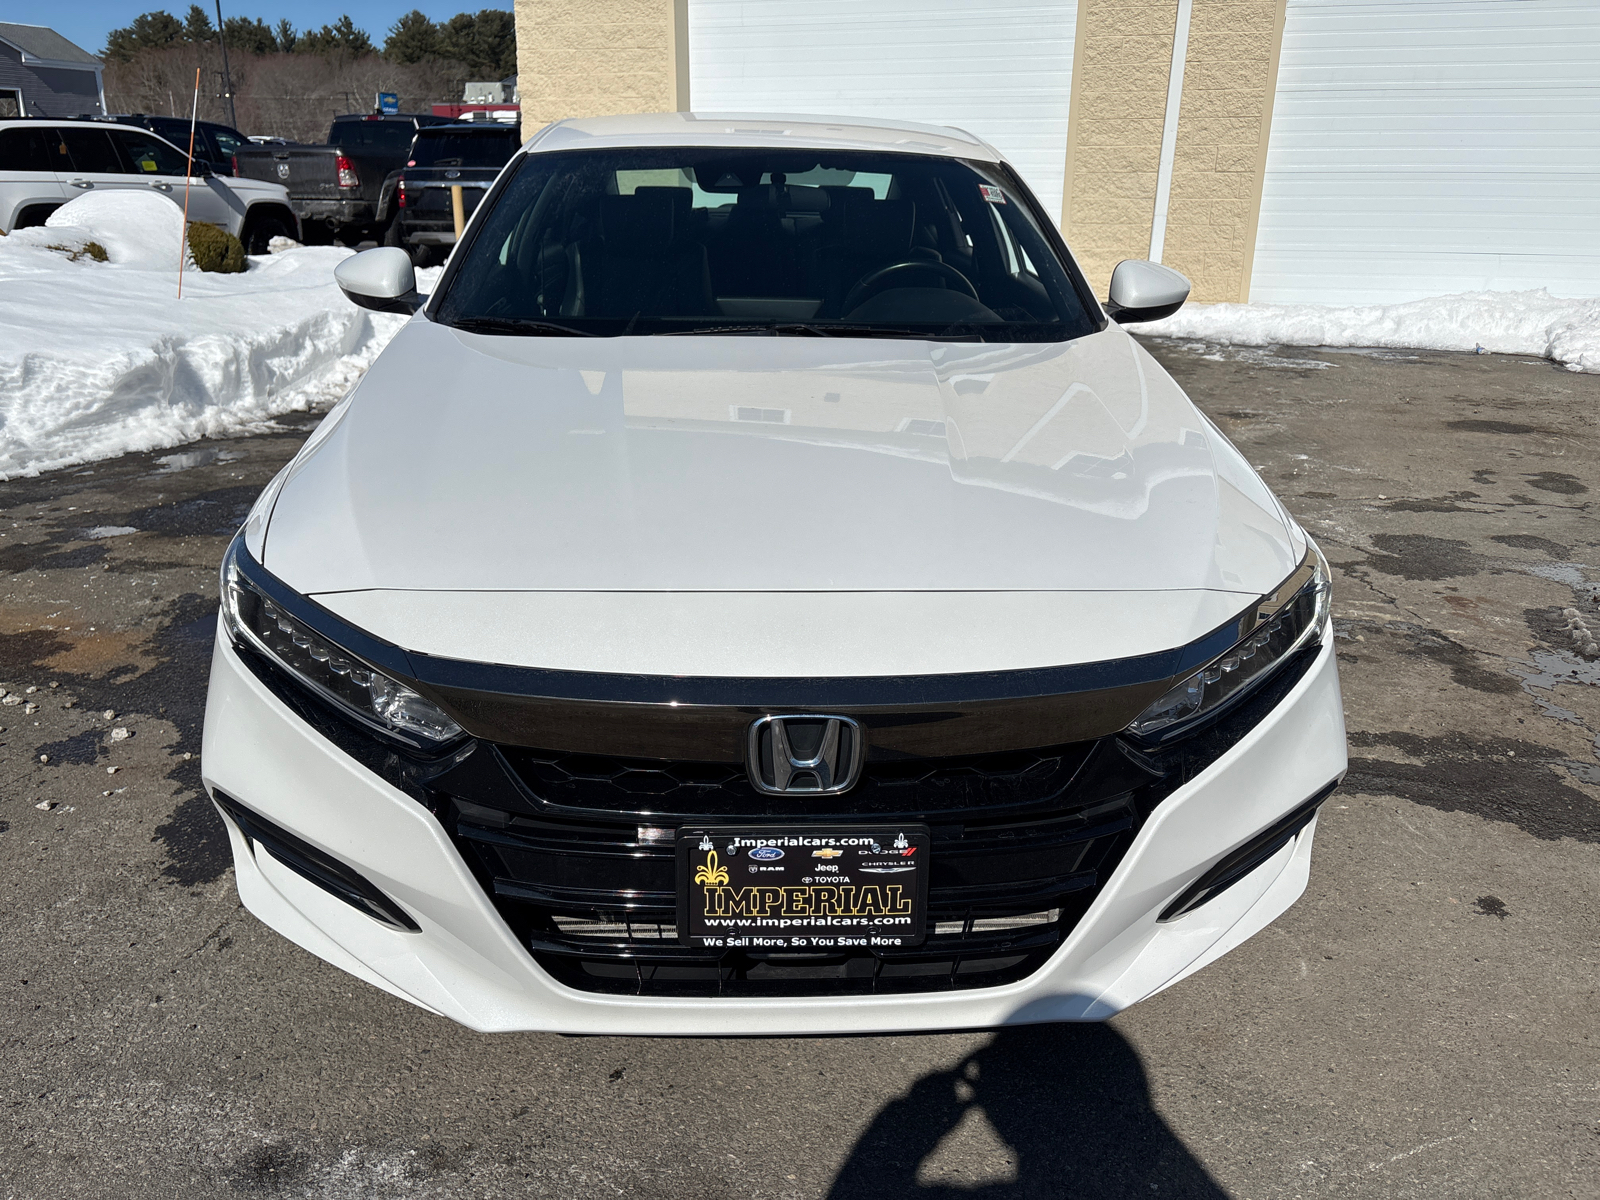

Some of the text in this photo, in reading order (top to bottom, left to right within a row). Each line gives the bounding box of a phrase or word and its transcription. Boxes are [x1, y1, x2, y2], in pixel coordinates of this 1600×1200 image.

[733, 836, 874, 848] Imperialcars.com
[814, 863, 839, 873] Jeep
[704, 885, 912, 916] IMPERIAL
[704, 916, 911, 928] www.imperialcars.com
[703, 937, 902, 947] We Sell More, So You Save More
